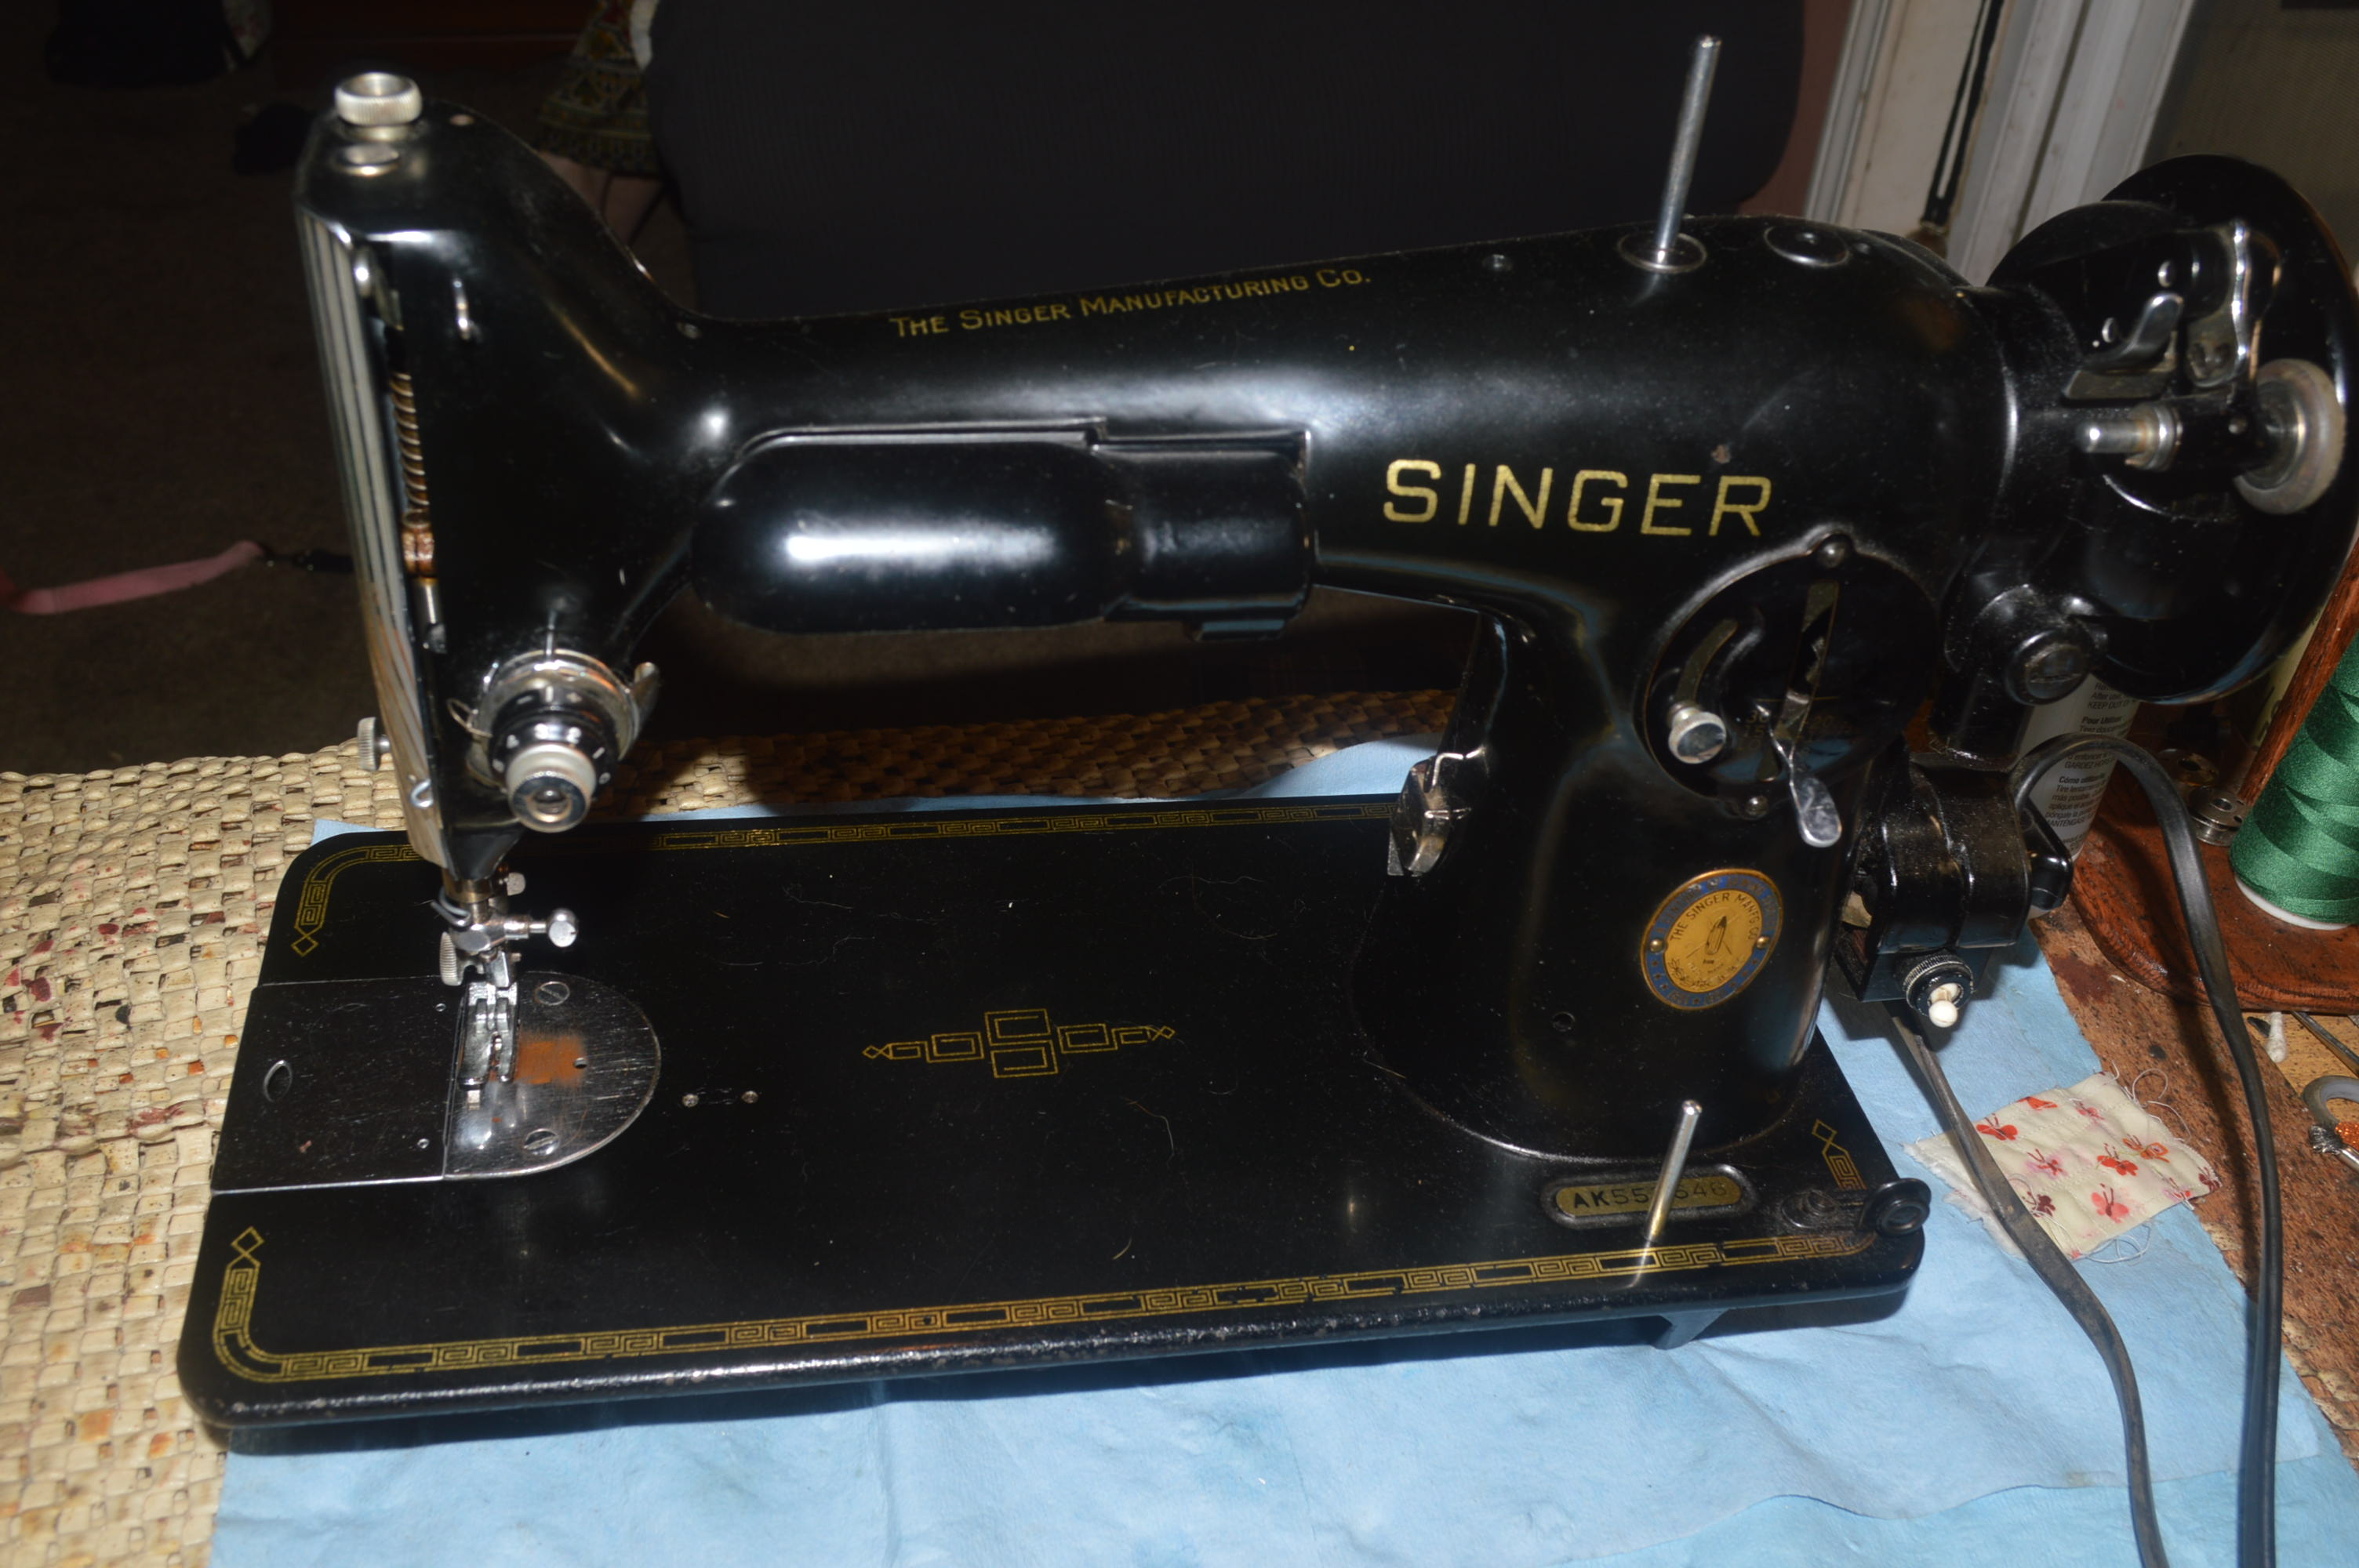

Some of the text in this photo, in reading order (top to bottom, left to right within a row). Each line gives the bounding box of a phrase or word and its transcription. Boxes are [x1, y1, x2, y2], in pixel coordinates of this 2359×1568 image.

[958, 303, 1072, 329] SINGER
[1079, 274, 1310, 318] MANUFACTURING
[1383, 459, 1772, 537] SINGER
[1670, 924, 1688, 941] THE
[1686, 892, 1730, 920] SINGER
